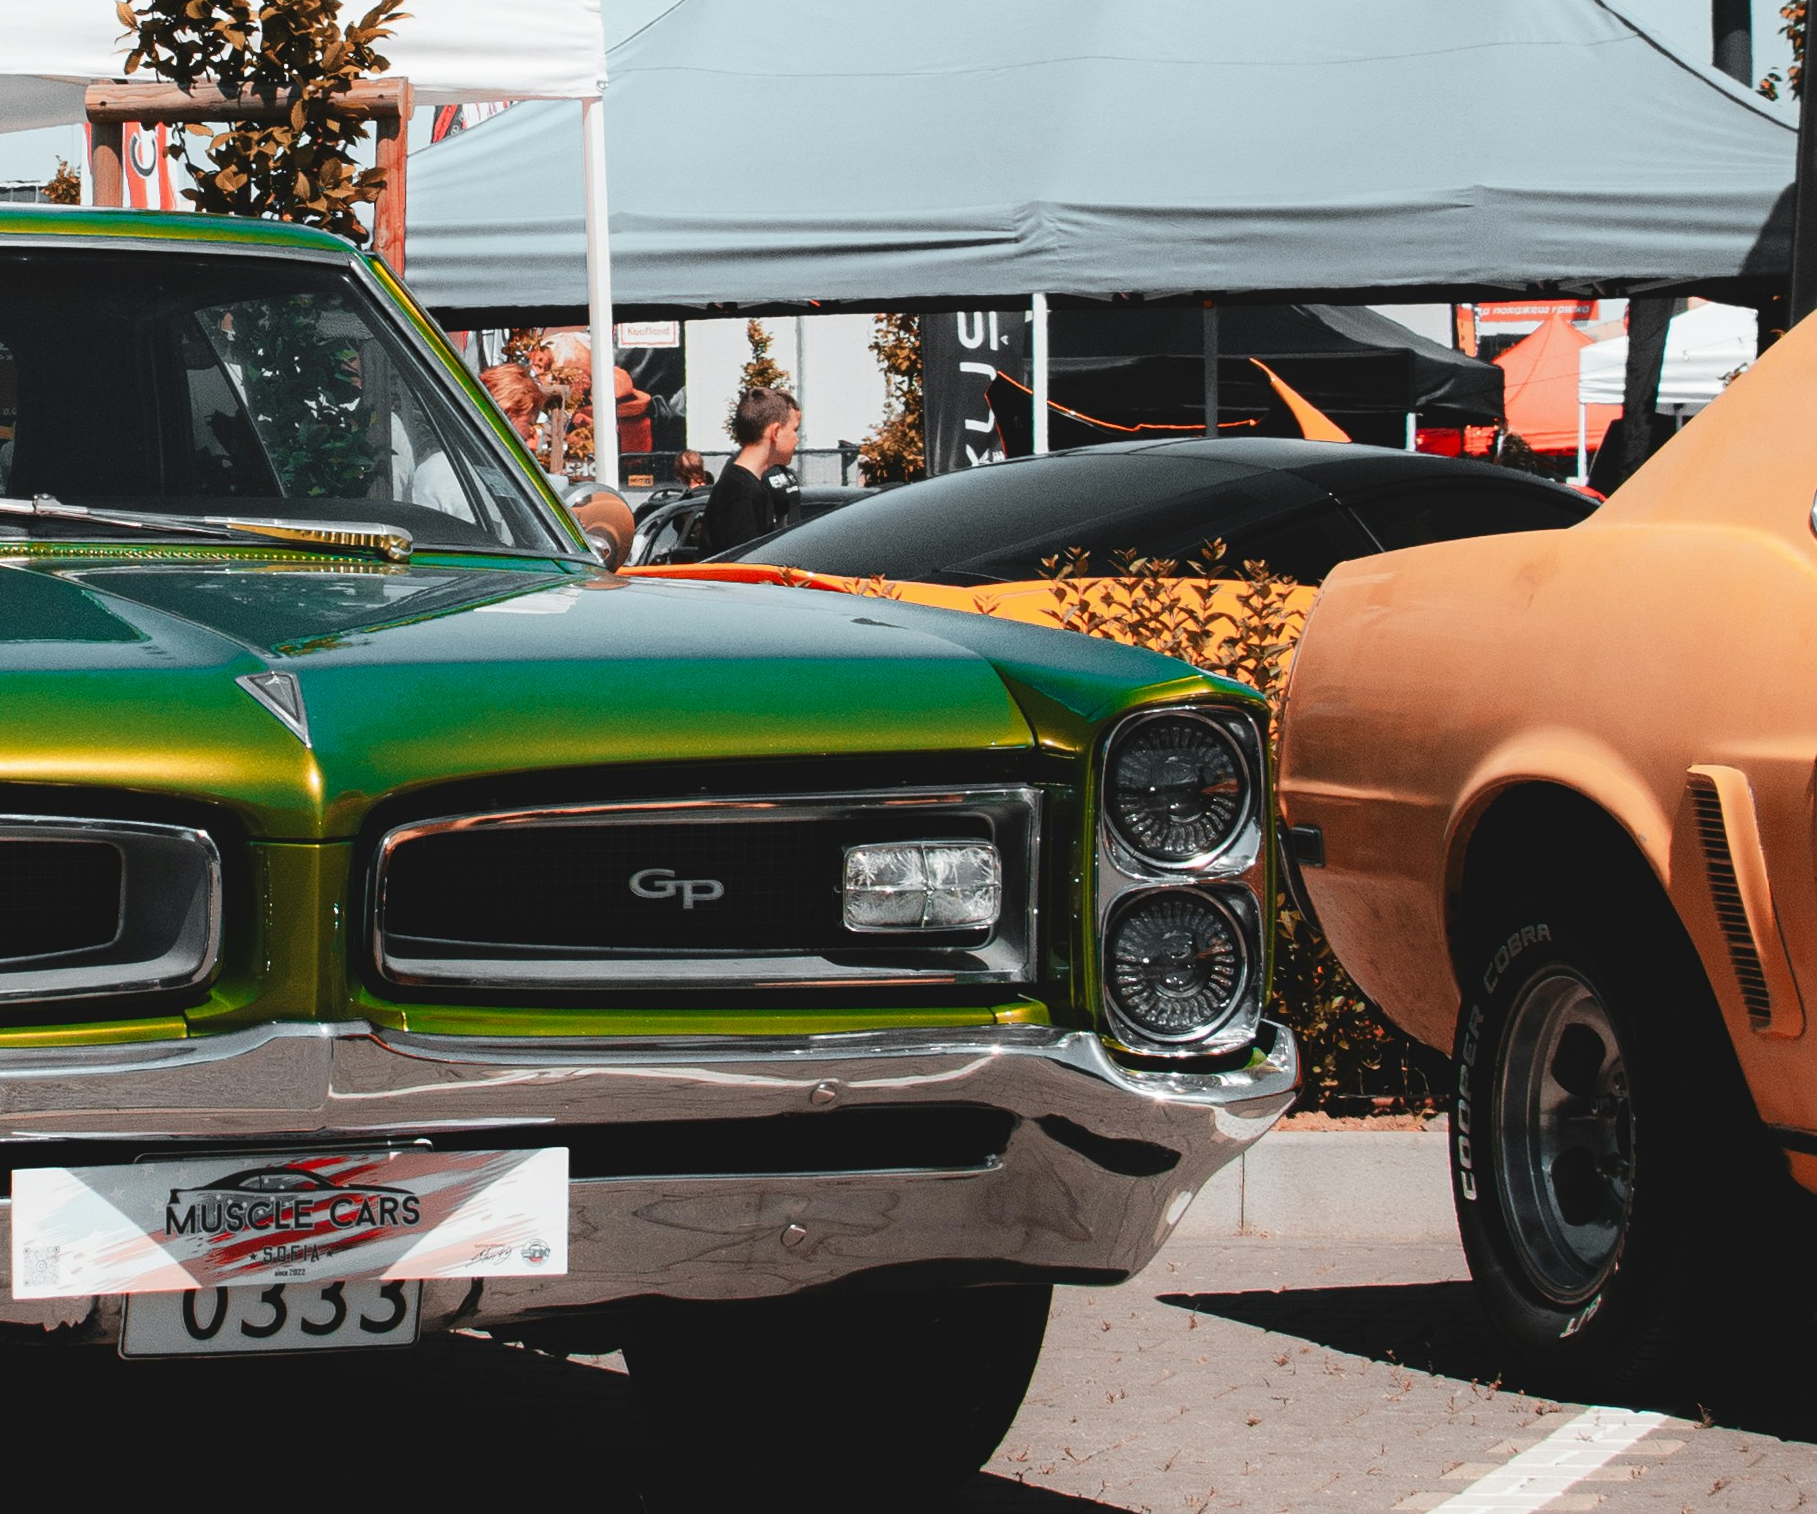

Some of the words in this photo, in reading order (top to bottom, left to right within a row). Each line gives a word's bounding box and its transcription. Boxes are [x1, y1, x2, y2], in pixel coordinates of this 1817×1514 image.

[1457, 1003, 1484, 1201] COOPER
[1483, 923, 1553, 995] COBRA
[166, 1199, 315, 1236] MUSCLE
[330, 1196, 422, 1228] CARS
[263, 1244, 320, 1264] SOFIA
[182, 1279, 408, 1341] 0333
